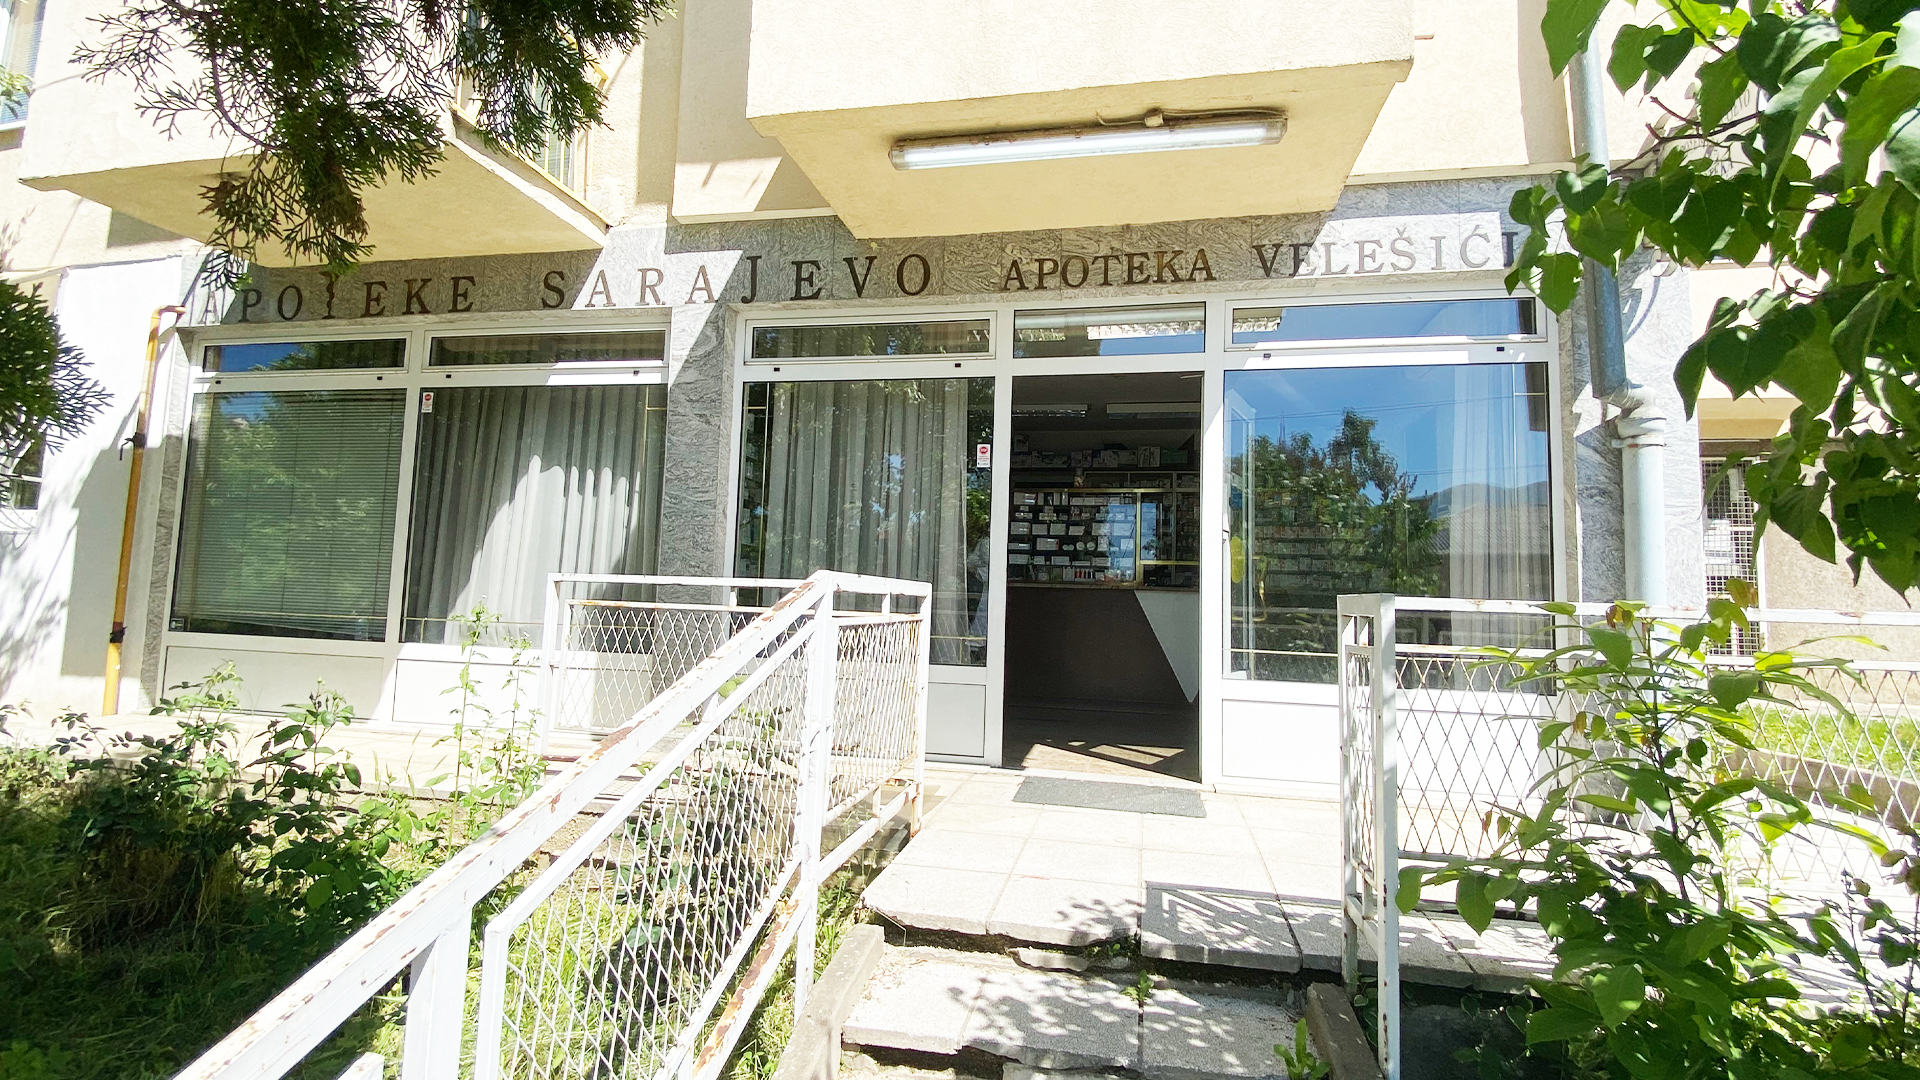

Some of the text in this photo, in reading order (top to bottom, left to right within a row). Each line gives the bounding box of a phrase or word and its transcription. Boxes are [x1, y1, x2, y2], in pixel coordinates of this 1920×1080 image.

[540, 253, 932, 309] SARAJEVO
[1001, 225, 1519, 291] APOTEKA VELEŠIĆI
